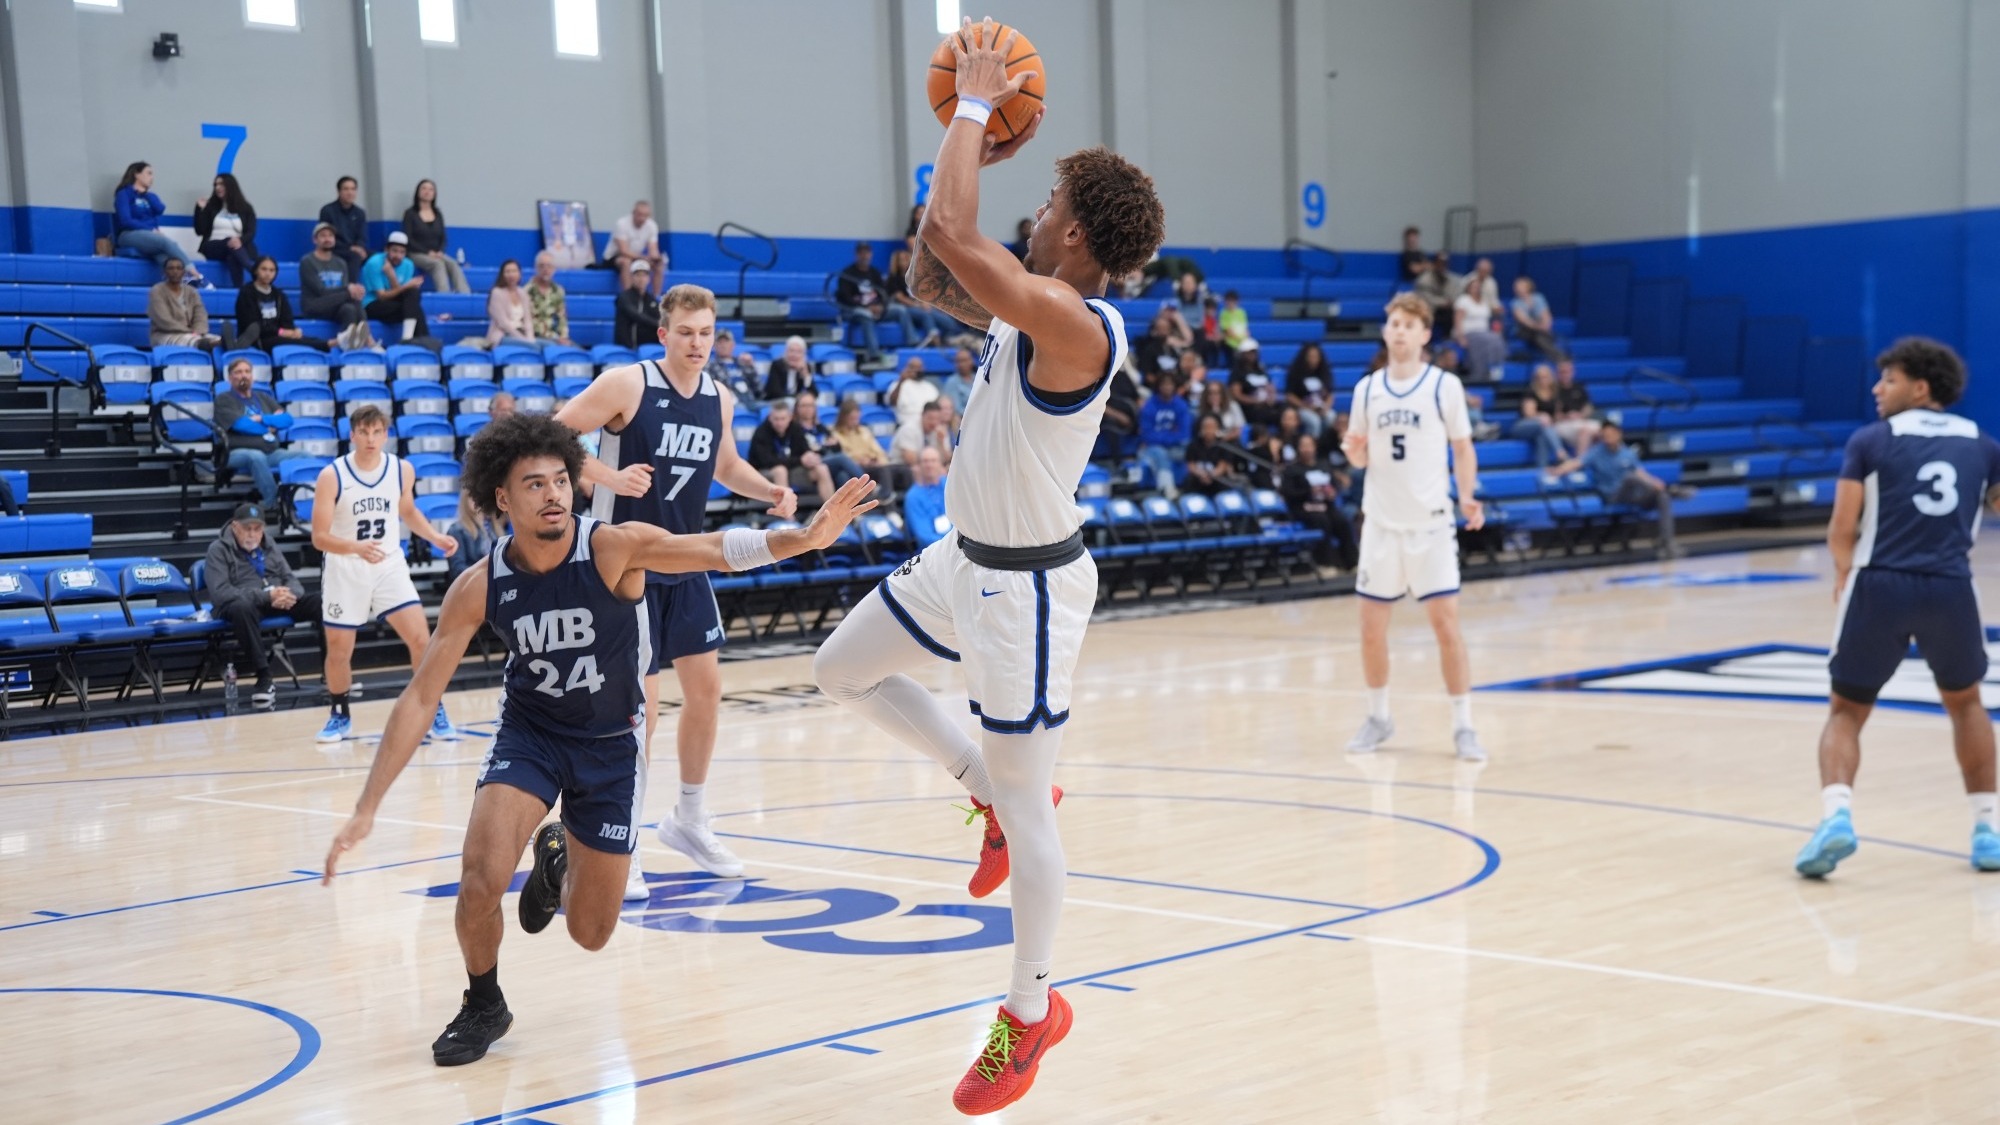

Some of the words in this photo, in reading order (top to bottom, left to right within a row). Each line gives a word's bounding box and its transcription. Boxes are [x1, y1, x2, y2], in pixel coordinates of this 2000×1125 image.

[201, 123, 247, 175] 7
[1303, 182, 1326, 229] 9
[1377, 409, 1420, 429] CSUSM
[655, 422, 713, 462] MB
[1391, 434, 1405, 461] 5
[664, 465, 697, 501] 7
[1912, 460, 1959, 516] 3
[353, 497, 391, 516] CSUSM
[356, 518, 386, 541] 23
[134, 566, 168, 579] CSUSM
[512, 607, 596, 656] MB
[528, 654, 606, 698] 24
[598, 822, 629, 840] MB
